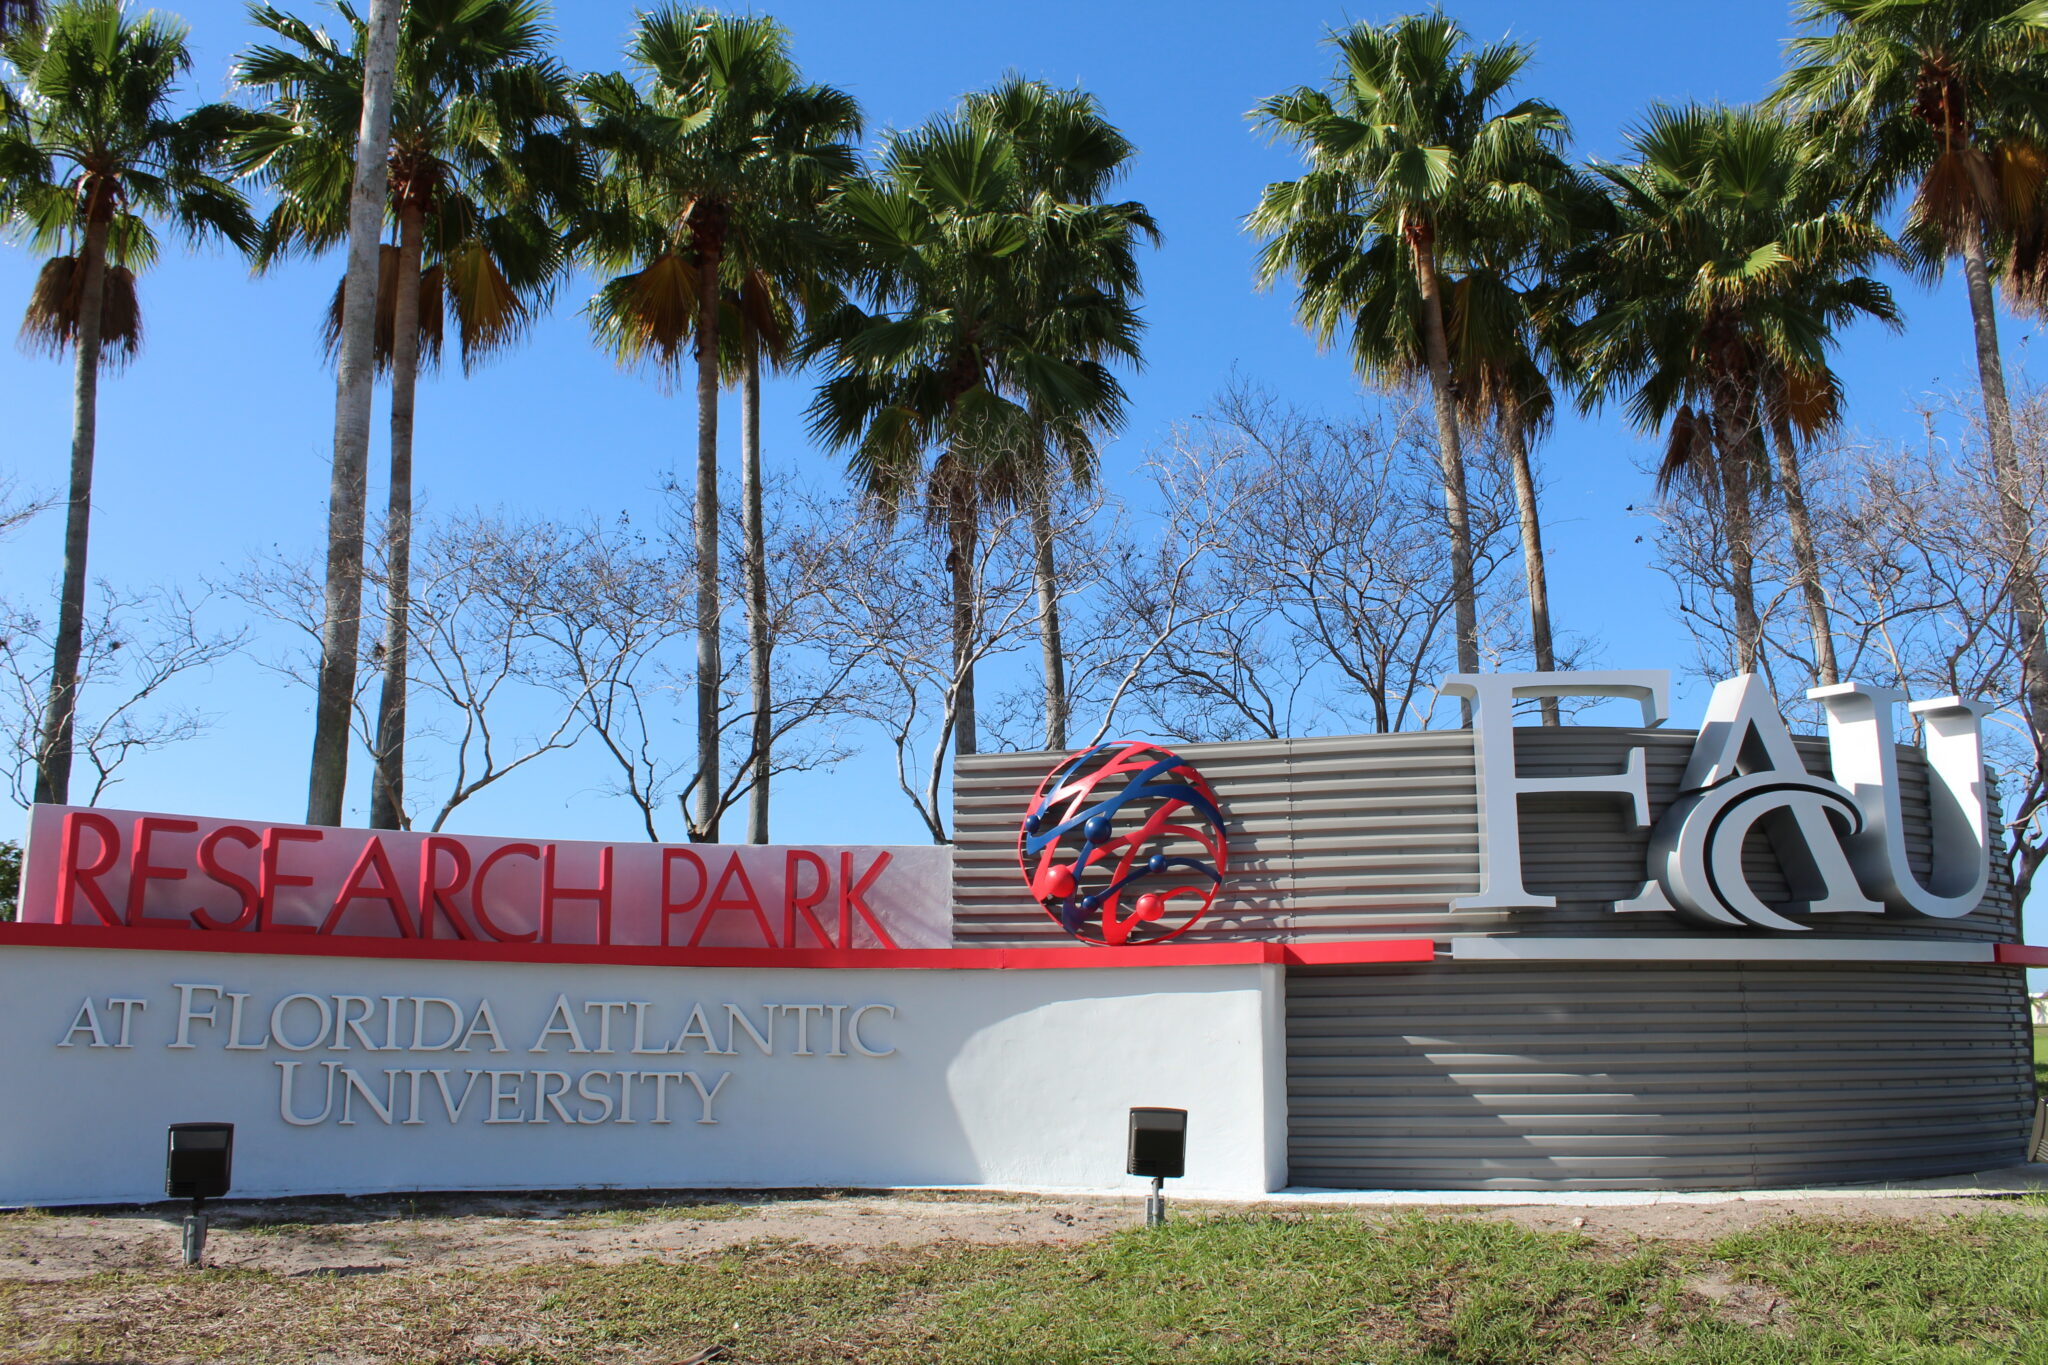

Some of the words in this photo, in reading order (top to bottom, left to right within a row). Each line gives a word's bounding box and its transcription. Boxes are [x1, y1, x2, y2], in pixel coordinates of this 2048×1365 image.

[1439, 669, 1994, 932] FAU
[54, 811, 613, 944] RESEARCH
[660, 847, 899, 950] PARK
[57, 995, 147, 1049] AT
[167, 982, 510, 1053] FLORIDA
[528, 992, 897, 1057] ATLANTIC
[273, 1060, 732, 1127] UNIVERSITY
